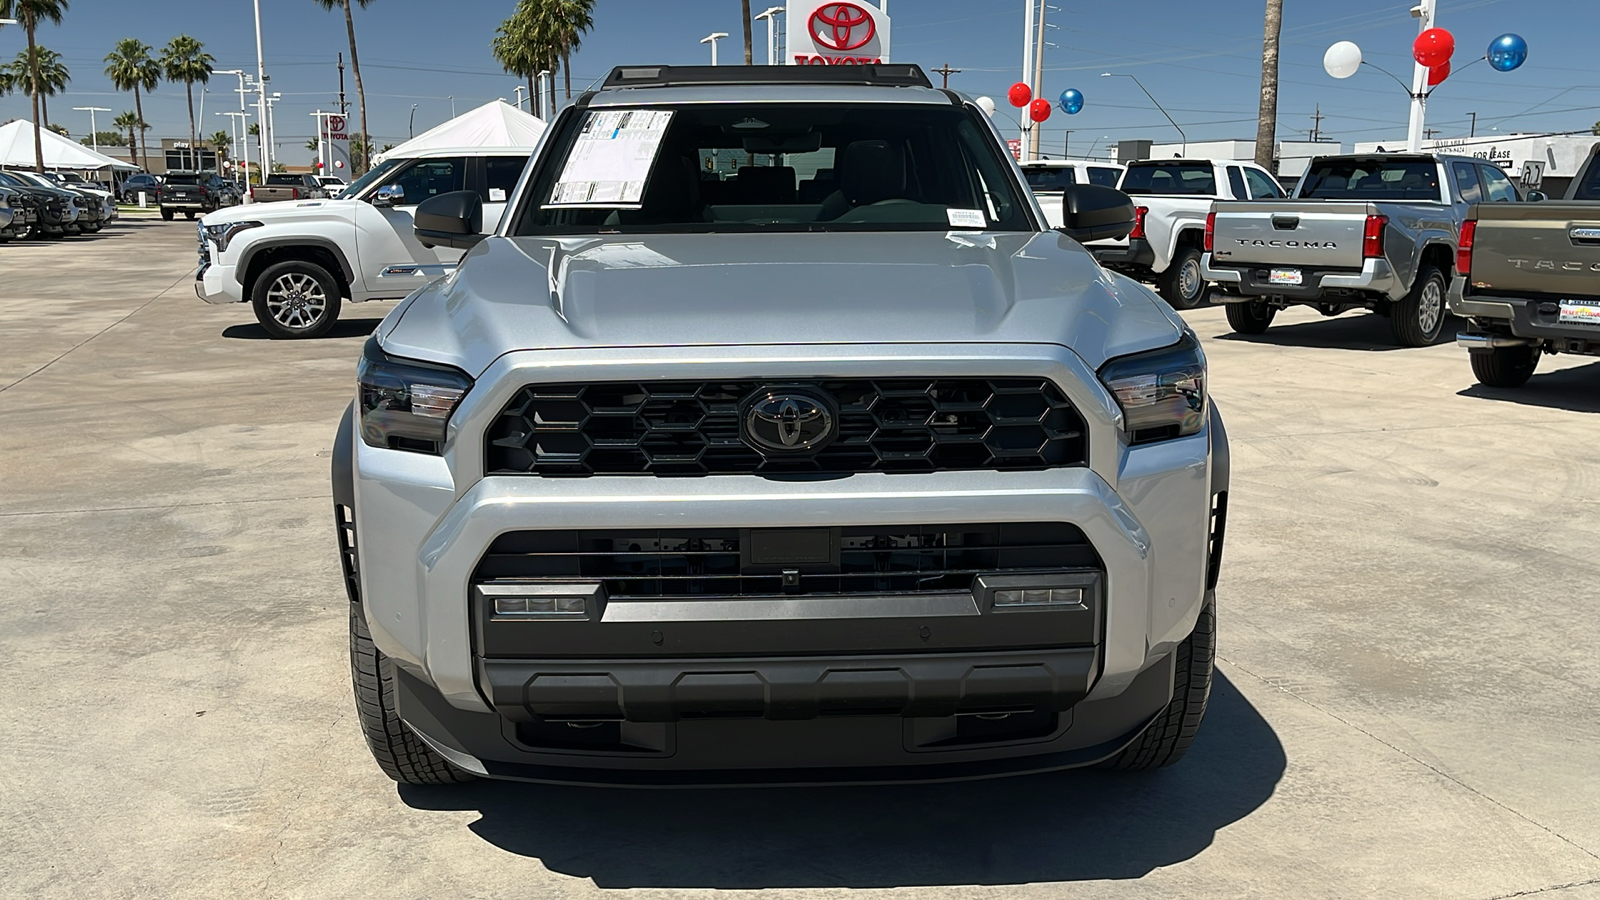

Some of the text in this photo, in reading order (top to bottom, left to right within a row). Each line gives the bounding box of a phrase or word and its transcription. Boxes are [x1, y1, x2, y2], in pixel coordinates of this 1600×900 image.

[1473, 150, 1510, 160] FOR LEASE
[1235, 239, 1337, 249] TACOMA
